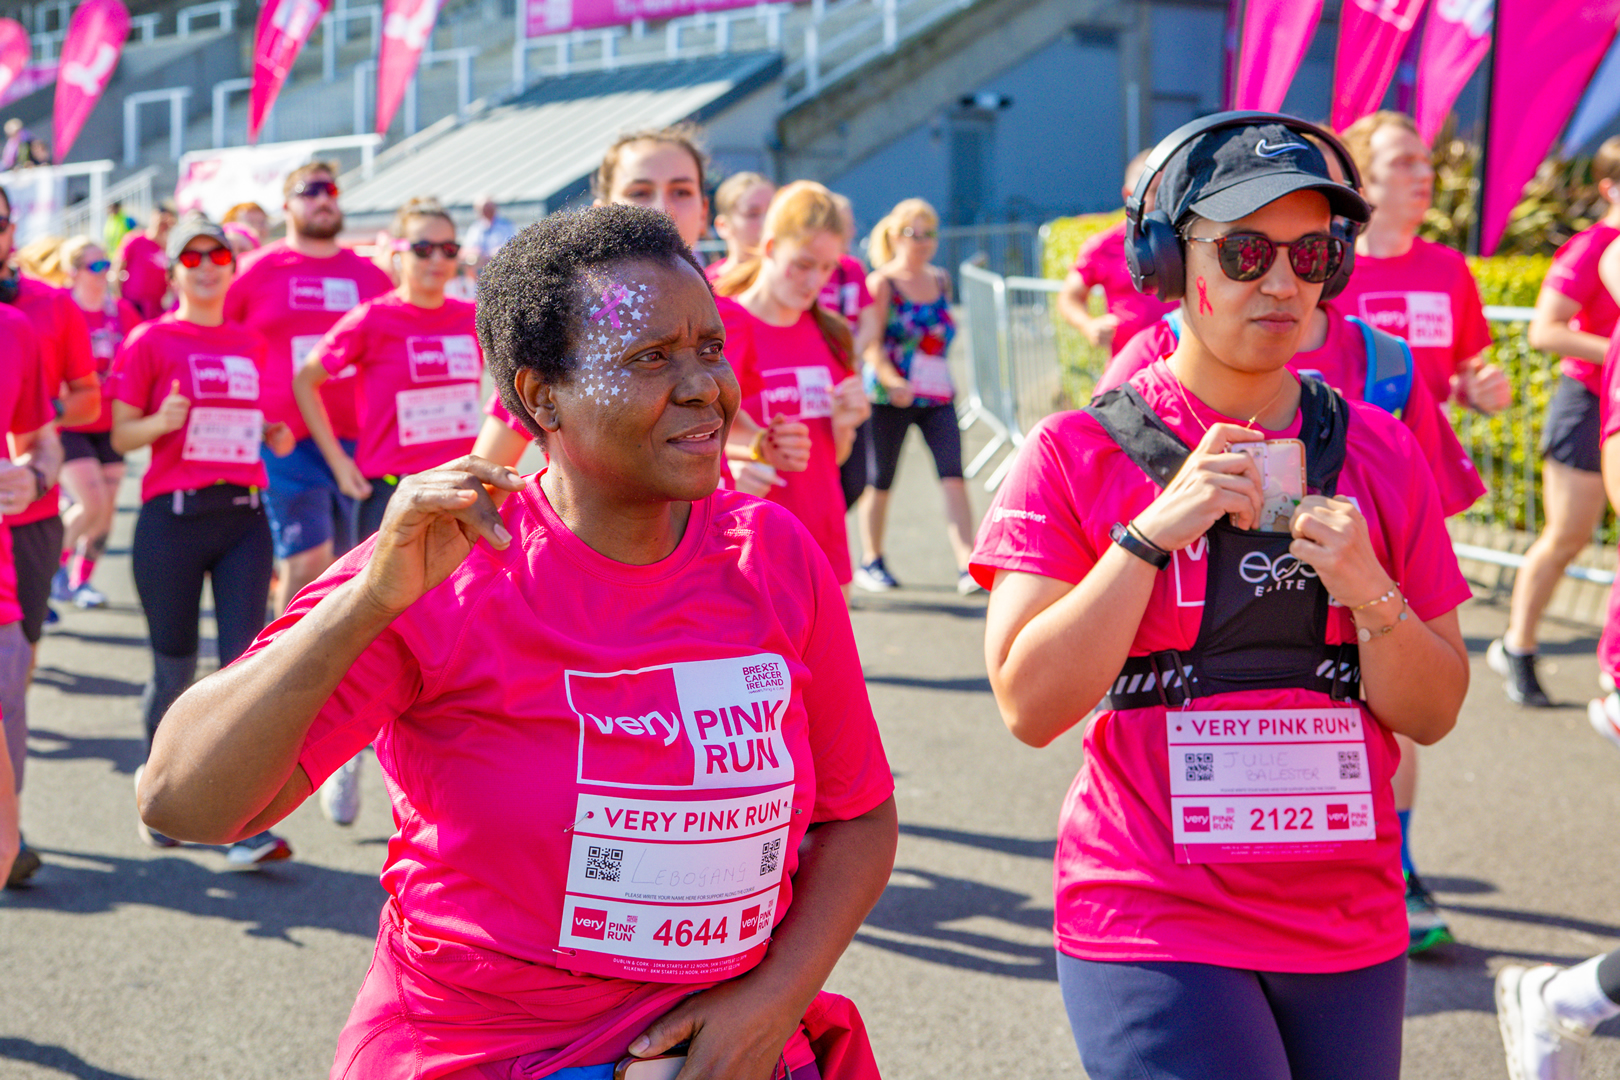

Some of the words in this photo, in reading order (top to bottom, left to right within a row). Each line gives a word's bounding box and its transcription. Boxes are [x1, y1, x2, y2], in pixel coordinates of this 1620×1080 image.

[744, 670, 782, 683] CANCER
[746, 678, 784, 690] IRELAND
[693, 699, 784, 741] PINK
[1191, 718, 1252, 736] VERY
[1259, 718, 1308, 735] PINK
[1313, 717, 1350, 734] RUN
[586, 710, 680, 747] very
[703, 736, 780, 775] RUN
[1223, 751, 1289, 769] JULIE
[604, 807, 677, 833] VERY
[683, 808, 741, 833] PINK
[745, 799, 781, 828] RUN
[1184, 814, 1209, 826] very
[1250, 807, 1314, 831] 2122
[1327, 812, 1349, 823] very
[1212, 823, 1233, 831] RUN
[625, 891, 642, 899] PLEASE
[759, 908, 773, 921] PINK
[575, 916, 604, 931] very
[608, 922, 637, 934] PINK
[742, 915, 760, 929] very
[758, 918, 770, 931] RUN
[607, 931, 632, 942] RUN
[652, 916, 728, 948] 4644
[612, 957, 631, 965] DUBLIN
[623, 965, 647, 973] KILKENNY
